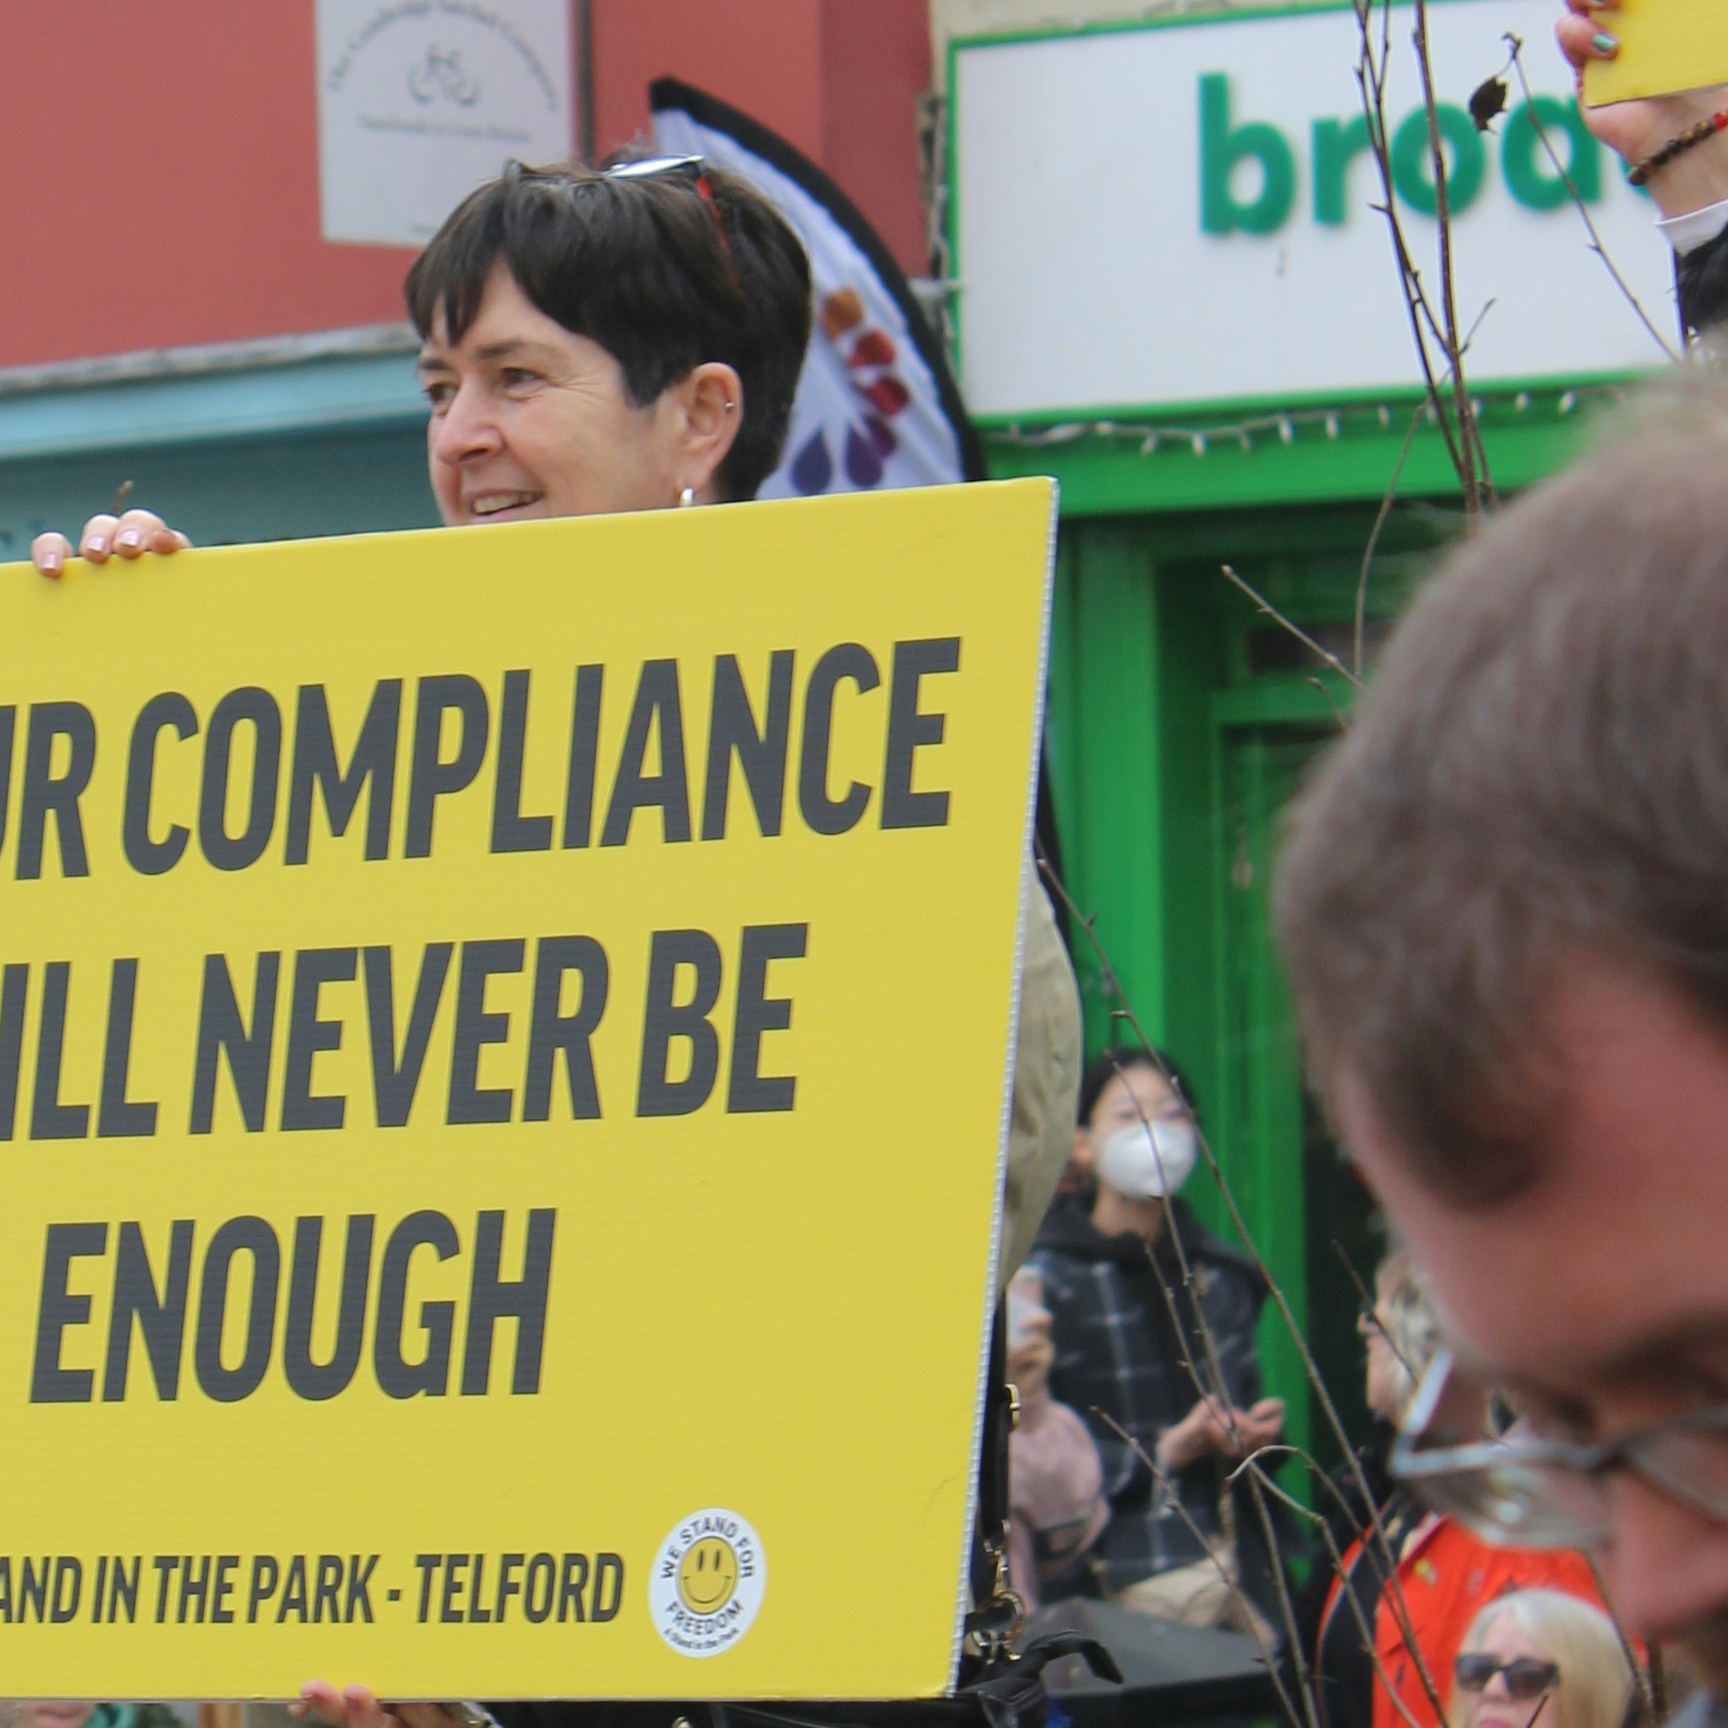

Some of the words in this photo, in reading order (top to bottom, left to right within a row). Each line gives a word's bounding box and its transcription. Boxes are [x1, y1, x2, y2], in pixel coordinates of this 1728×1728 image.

[1197, 71, 1654, 237] broa
[122, 636, 961, 877] COMPLIANCE
[188, 935, 610, 1136] NEVER
[635, 922, 809, 1118] BE
[29, 1207, 557, 1404] ENOUGH
[91, 1555, 142, 1624] IN
[153, 1555, 240, 1624] THE
[246, 1554, 380, 1624] PARK
[415, 1552, 624, 1624] TELFORD
[660, 1545, 682, 1579] WE
[679, 1516, 739, 1545] STAND
[734, 1536, 756, 1579] FOR
[664, 1598, 745, 1636] FREEDOM
